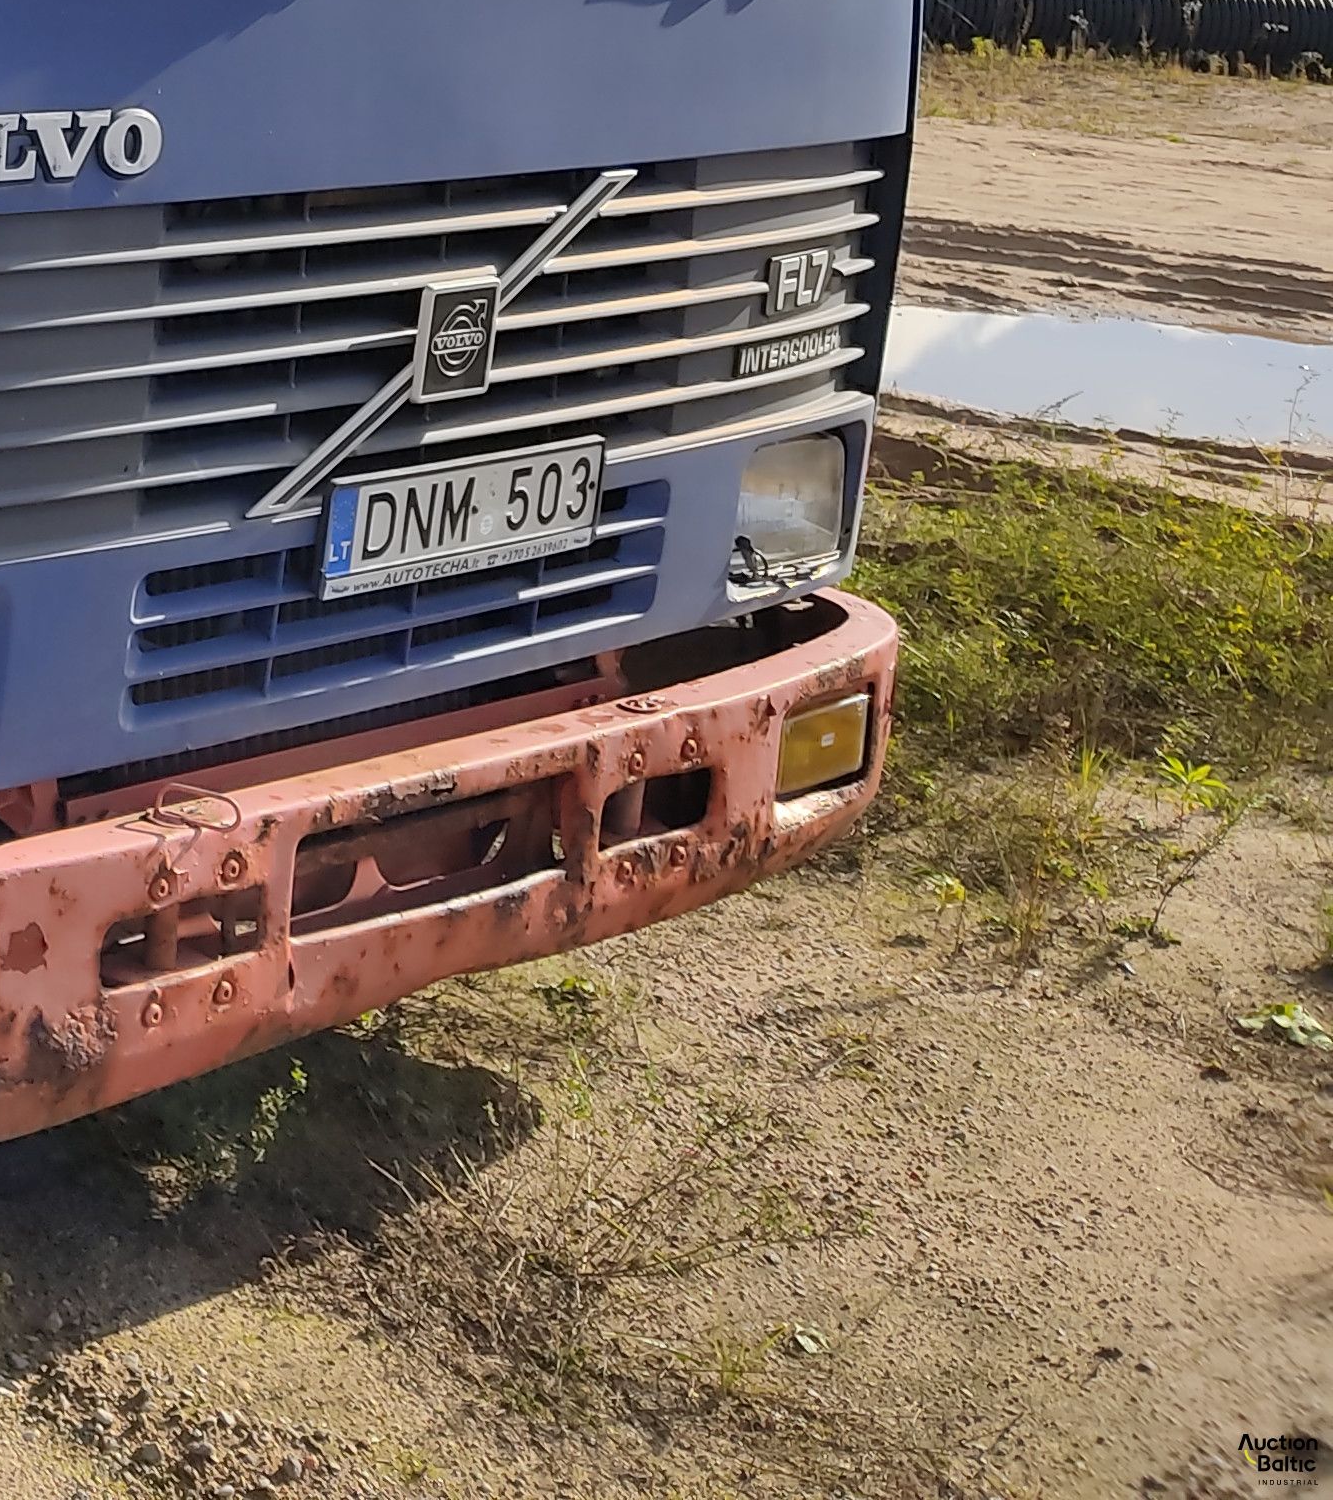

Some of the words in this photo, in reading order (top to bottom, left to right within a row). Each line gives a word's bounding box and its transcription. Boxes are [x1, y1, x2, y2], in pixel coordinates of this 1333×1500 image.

[776, 249, 830, 311] FL7
[434, 332, 483, 350] VOLVO
[739, 325, 841, 375] INTERCOOLER
[361, 476, 477, 561] DNM
[505, 456, 592, 532] 503
[328, 540, 351, 563] LT
